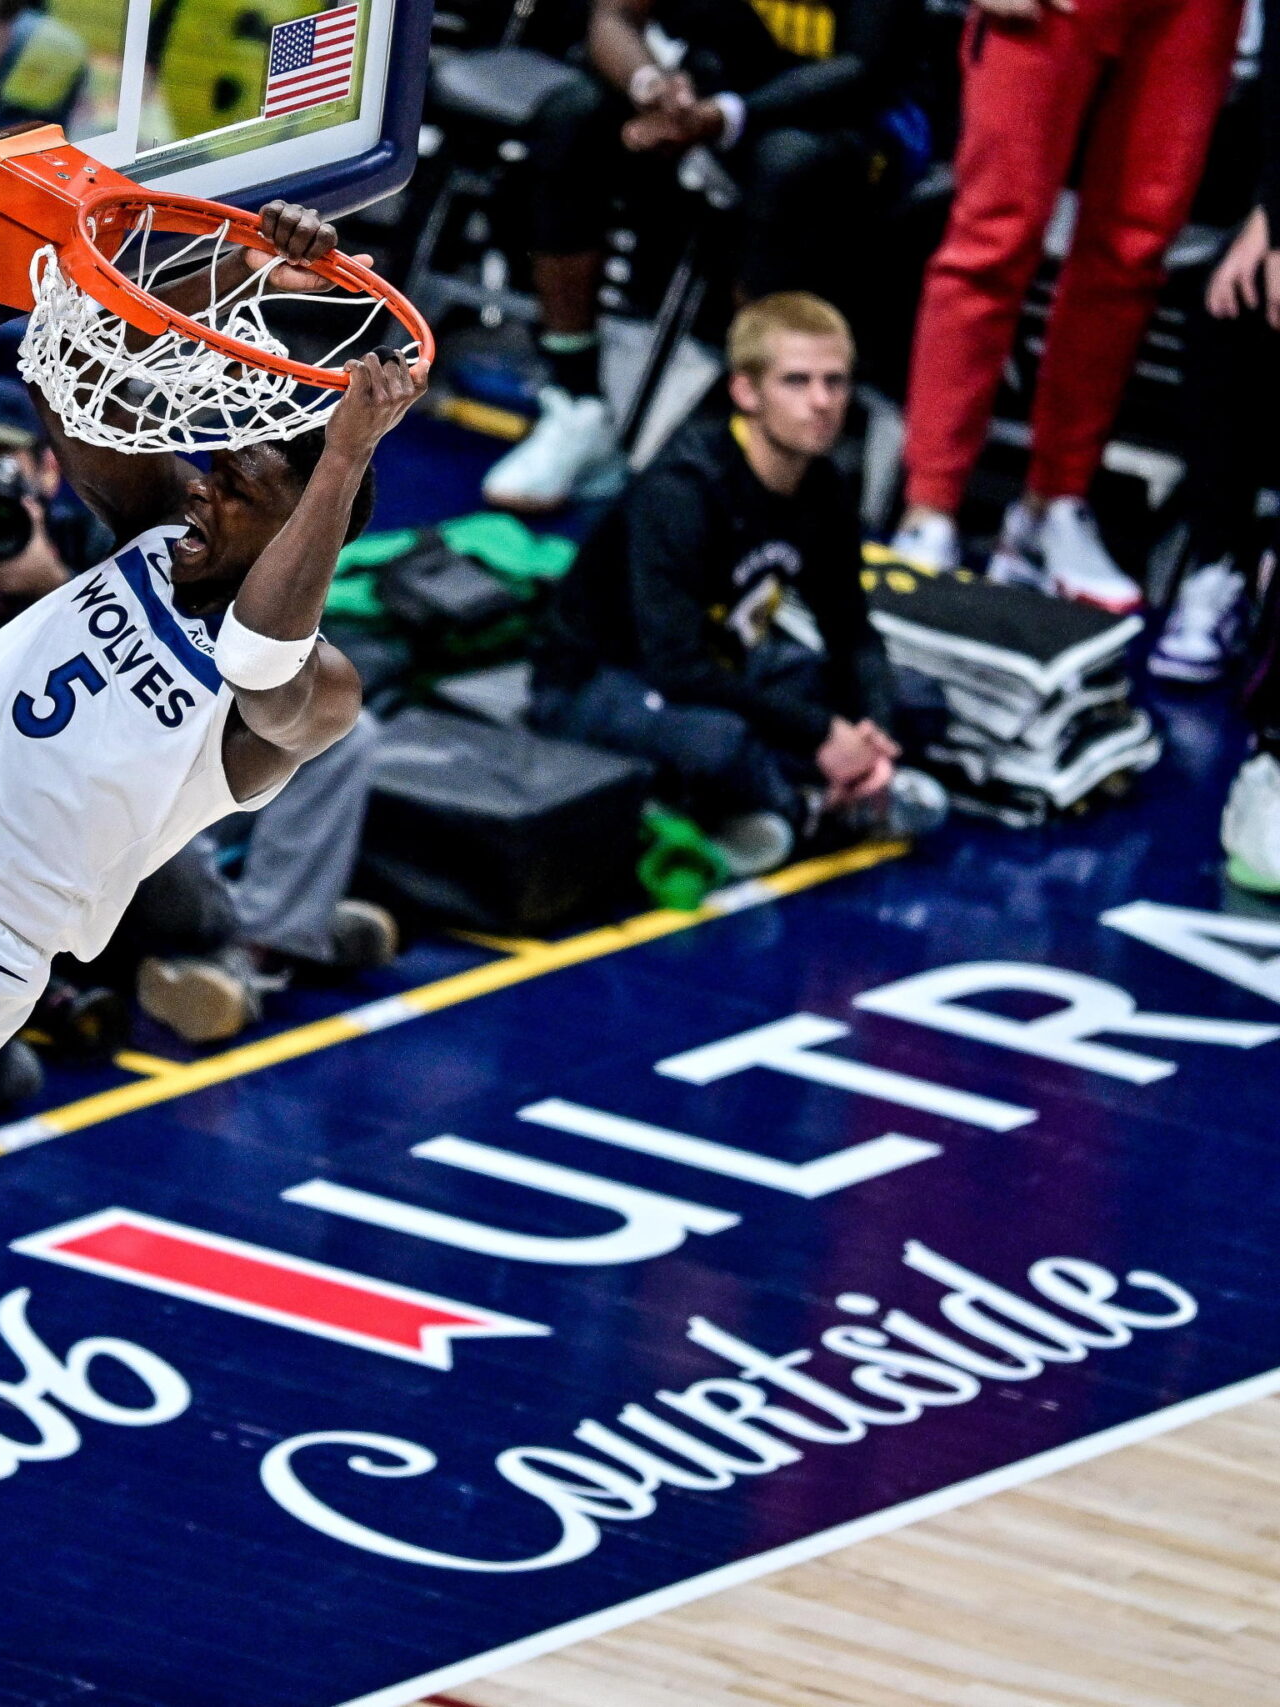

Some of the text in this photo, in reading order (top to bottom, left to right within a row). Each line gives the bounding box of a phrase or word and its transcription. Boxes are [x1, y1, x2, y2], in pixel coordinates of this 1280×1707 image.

[12, 651, 108, 739] 5
[71, 572, 196, 728] WOLVES
[282, 900, 1280, 1266] ULTRA
[261, 1241, 1198, 1573] Courtside
